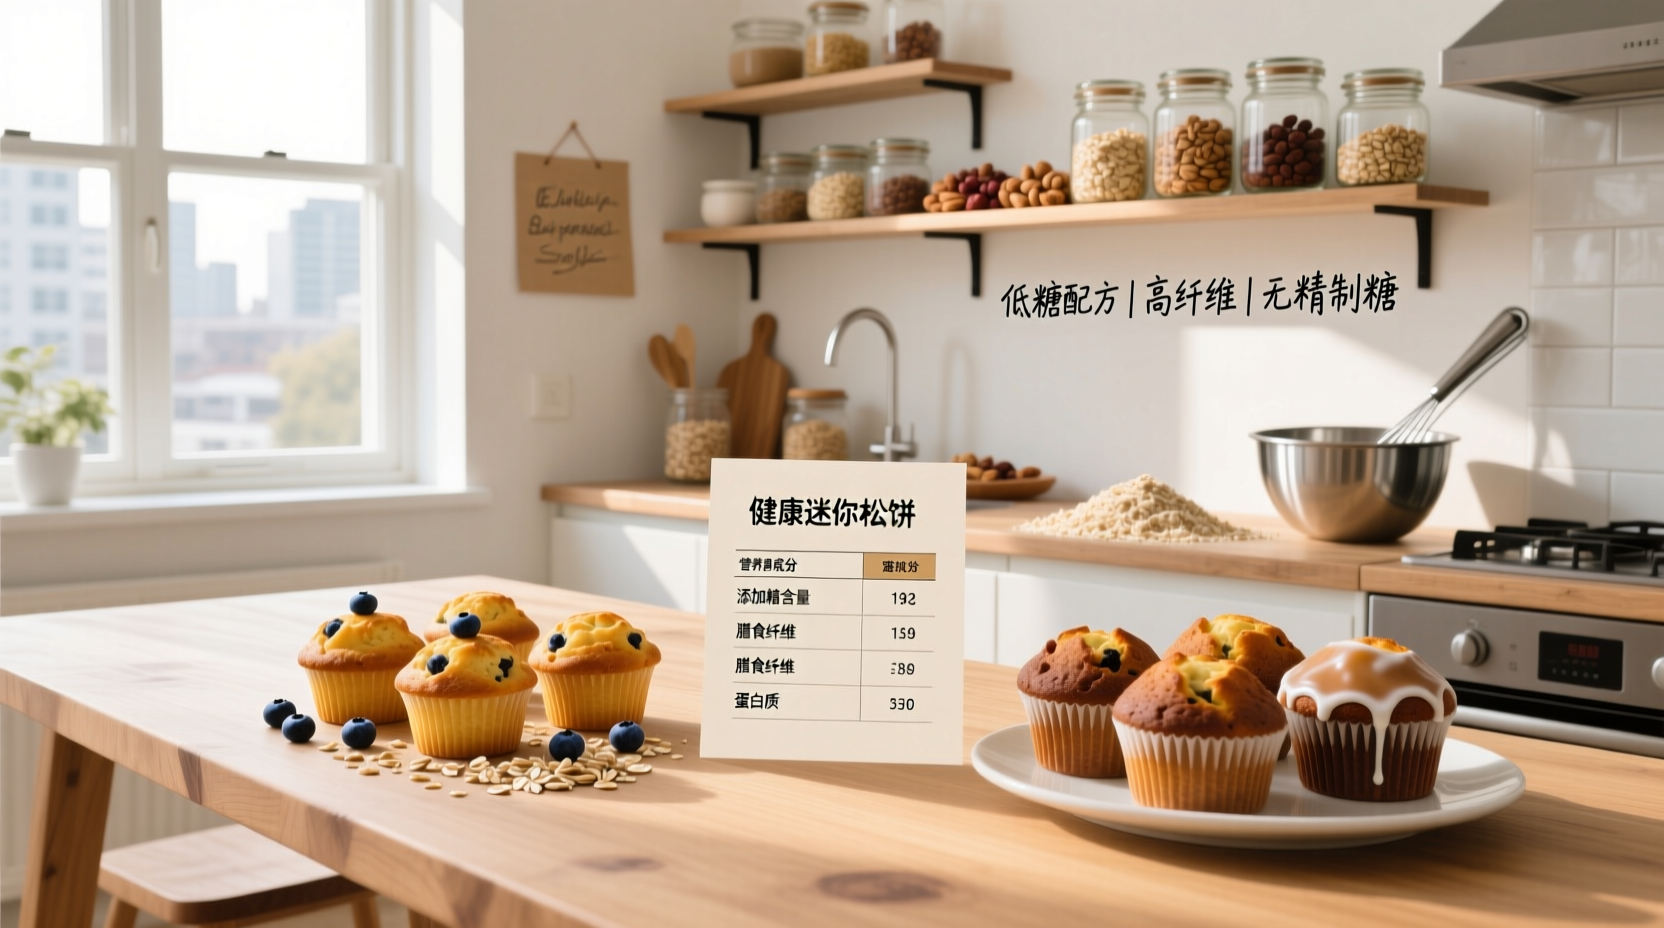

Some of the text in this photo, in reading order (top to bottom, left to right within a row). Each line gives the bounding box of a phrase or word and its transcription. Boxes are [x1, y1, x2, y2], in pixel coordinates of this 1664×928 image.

[749, 495, 916, 529] 健康迷你松饼
[734, 691, 780, 710] 蛋白质
